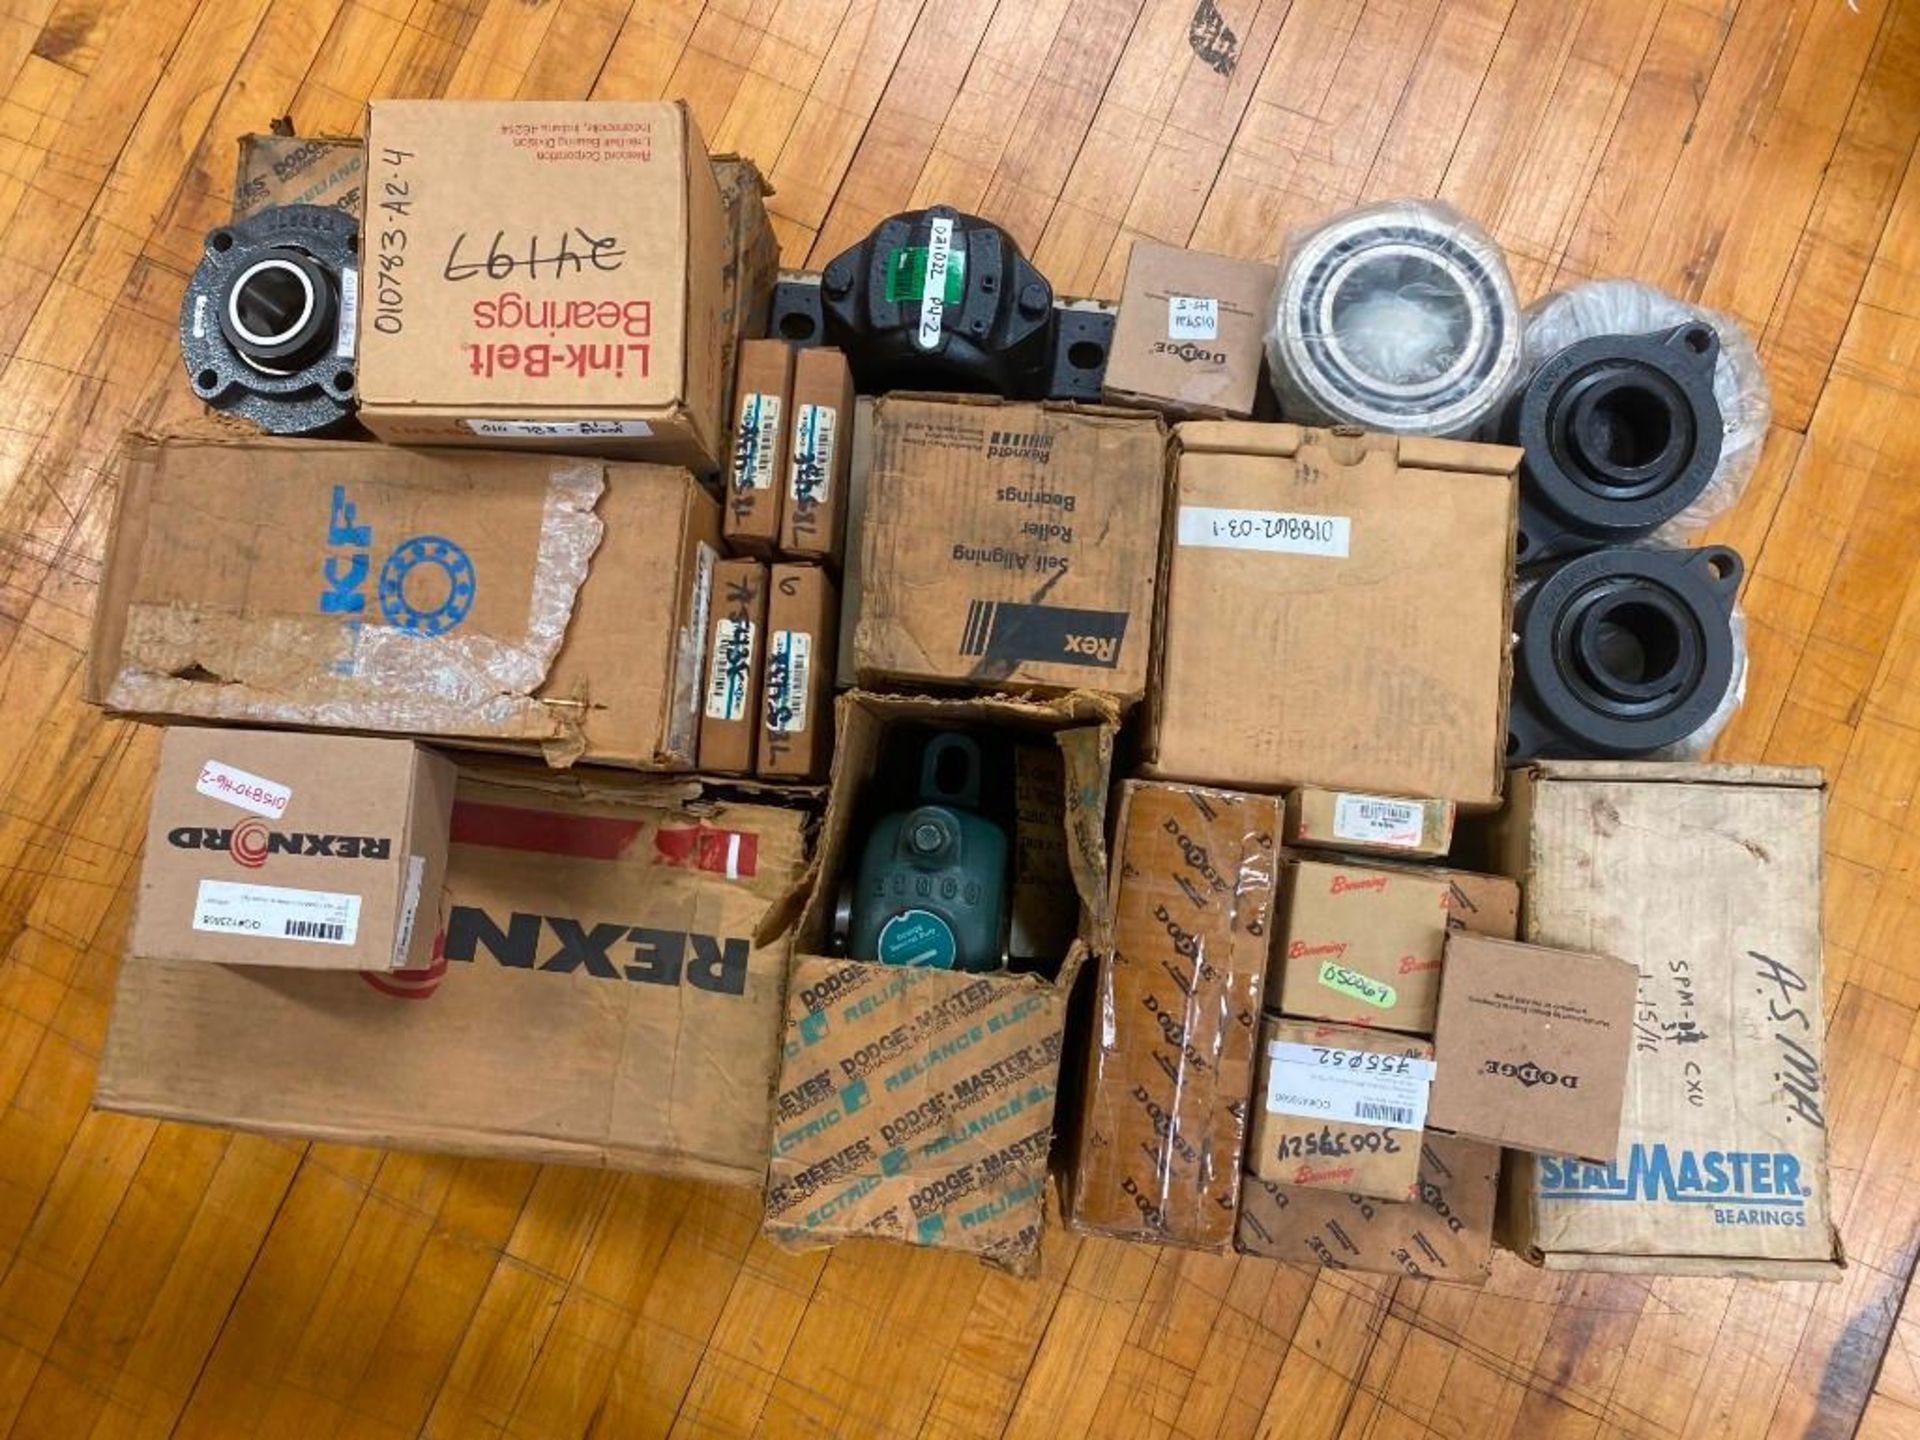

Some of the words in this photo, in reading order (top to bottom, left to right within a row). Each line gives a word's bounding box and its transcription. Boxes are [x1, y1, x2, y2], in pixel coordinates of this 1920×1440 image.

[536, 148, 601, 162] Corporation
[473, 291, 651, 337] Bearings
[468, 344, 651, 378] Link-Belt
[1153, 341, 1226, 364] DODGE
[987, 446, 1050, 465] Rexnord
[996, 487, 1076, 513] Bearings
[1019, 521, 1073, 543] Roller
[951, 544, 1029, 570] Aligning
[1036, 555, 1069, 573] Self
[320, 484, 371, 675] KF
[1063, 633, 1118, 663] Rex
[168, 817, 391, 870] REXNORD
[1163, 817, 1227, 892] DODGE
[986, 994, 1043, 1035] ELEC
[779, 1068, 831, 1111] EVES
[839, 1024, 910, 1076] DODGE
[914, 978, 994, 1028] MASTER
[1484, 1060, 1579, 1090] DODGE
[793, 1137, 872, 1190] REEVES
[880, 1089, 947, 1142] DODGE
[953, 1044, 1033, 1098] MASTER
[908, 1165, 975, 1211] DODGE
[1540, 1143, 1802, 1200] SEALMASTER
[1121, 1176, 1168, 1233] DOD
[1714, 1208, 1806, 1227] BEARINGS
